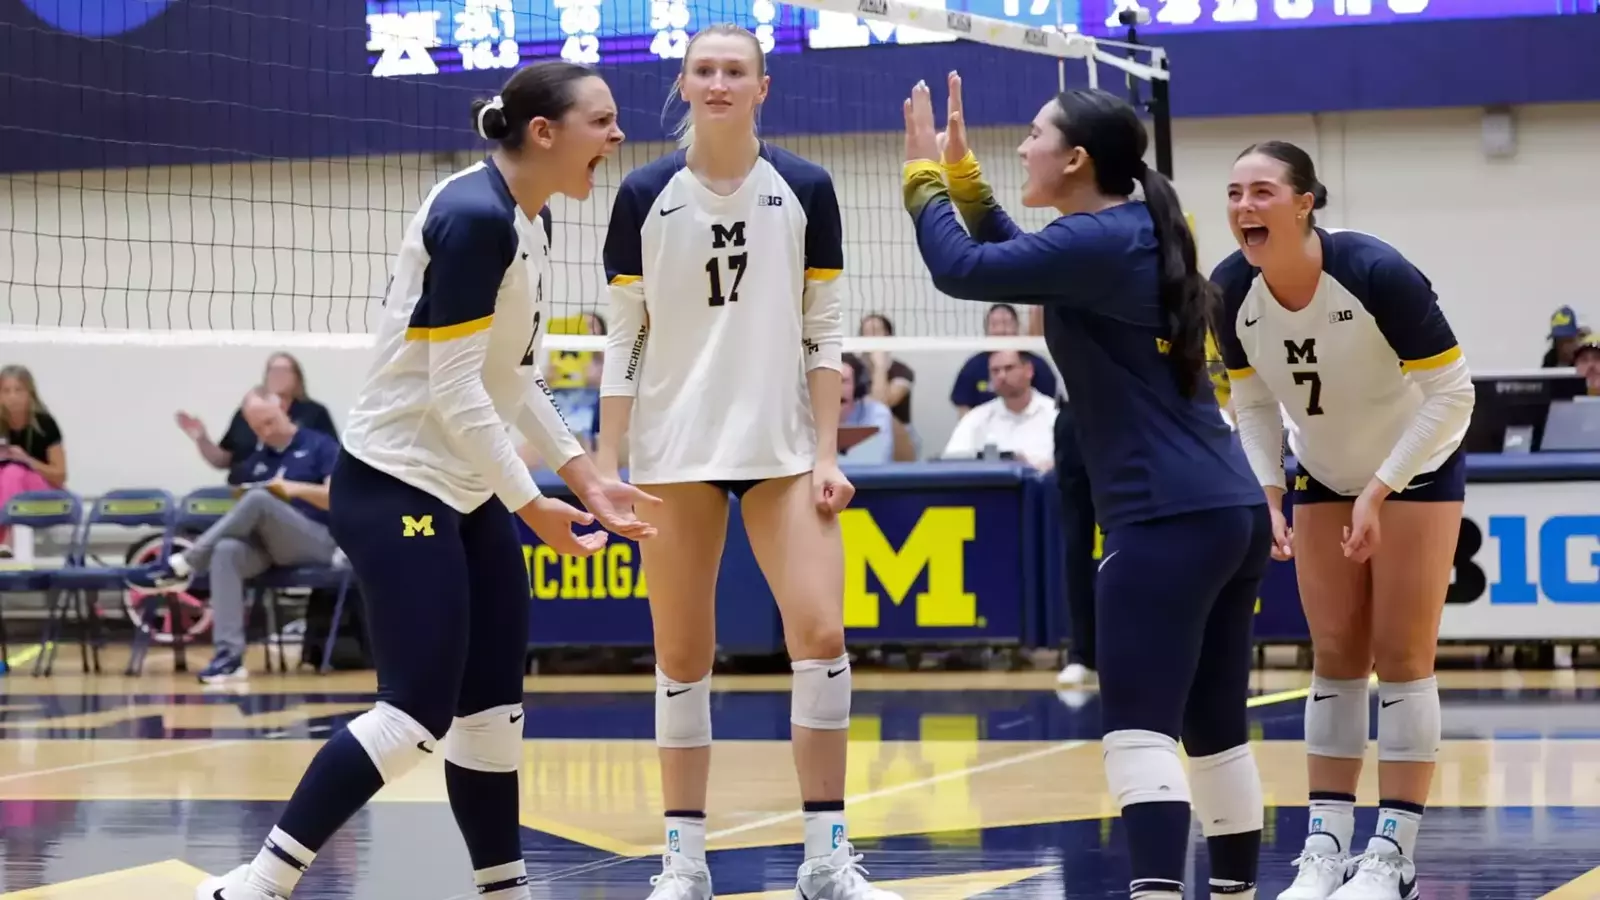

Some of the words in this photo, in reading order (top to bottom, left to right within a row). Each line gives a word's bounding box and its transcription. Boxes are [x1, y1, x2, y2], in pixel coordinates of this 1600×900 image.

[711, 221, 746, 248] M
[705, 252, 748, 307] 17
[625, 324, 647, 381] MICHIGAN
[1284, 338, 1318, 364] M
[1292, 371, 1324, 416] 7
[402, 515, 435, 537] M
[838, 506, 977, 628] M
